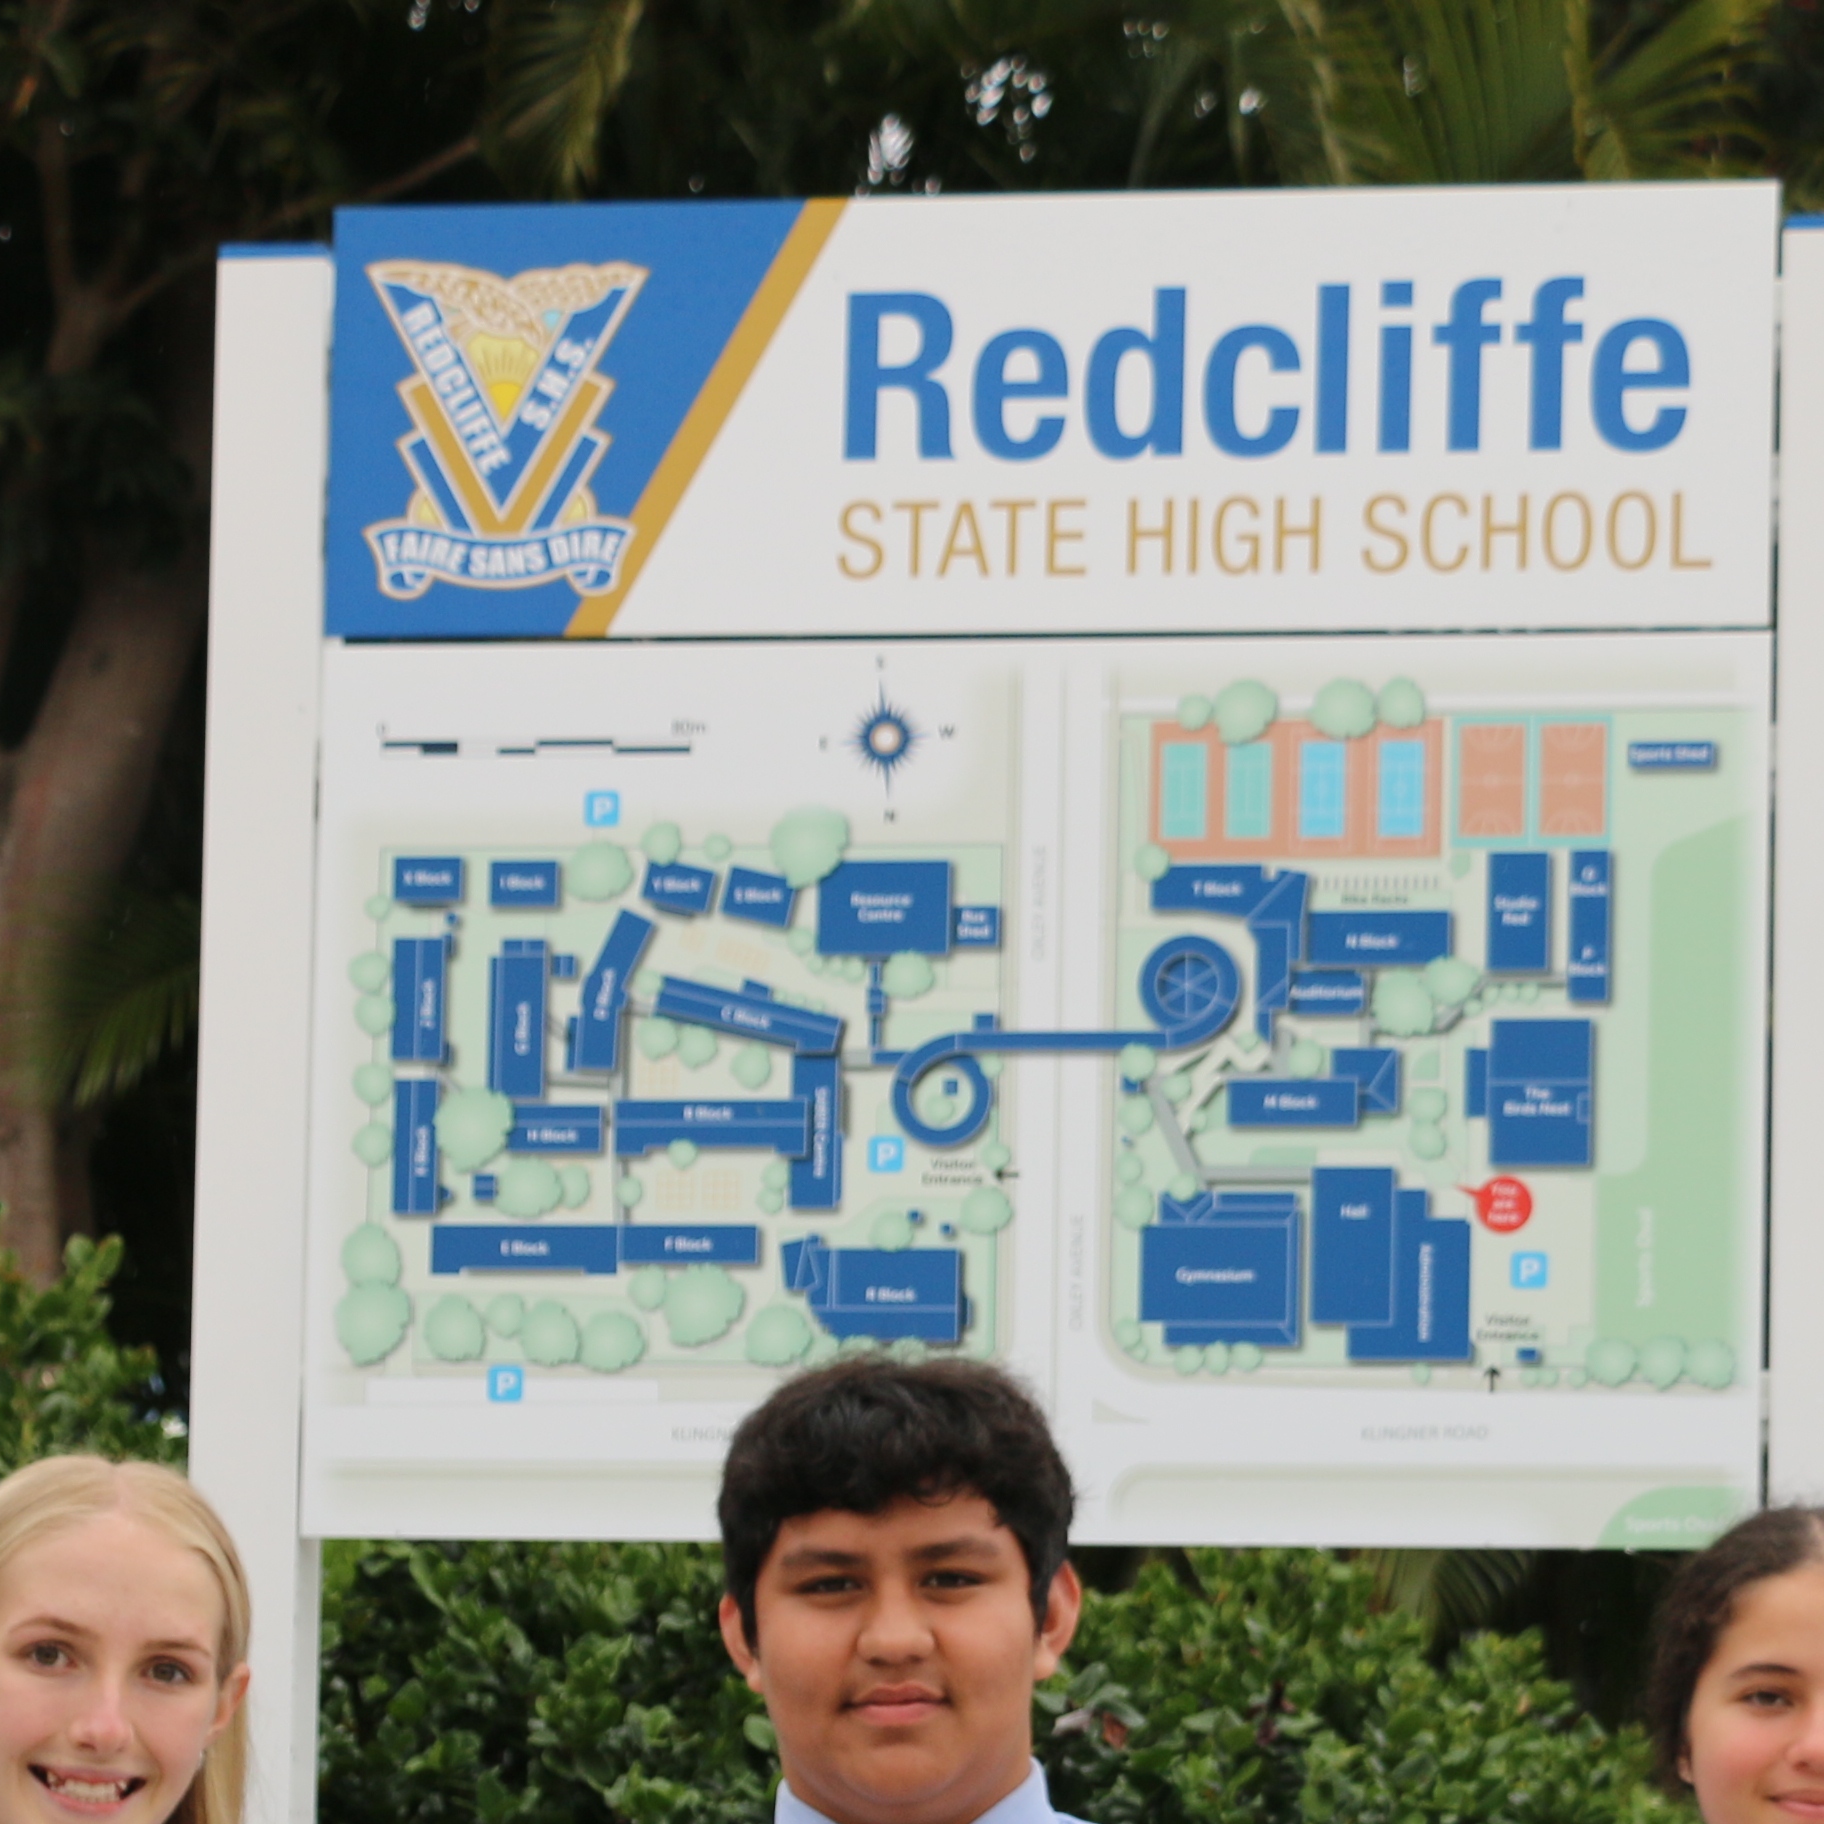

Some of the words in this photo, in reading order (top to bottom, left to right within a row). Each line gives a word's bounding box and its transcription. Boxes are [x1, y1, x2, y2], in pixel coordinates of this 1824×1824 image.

[842, 275, 1692, 462] Redcliffe
[402, 302, 511, 474] REDCLIFFE
[836, 497, 1088, 580] STATE
[1126, 495, 1323, 577] HIGH
[1360, 490, 1714, 574] SCHOOL
[384, 530, 468, 569] FAIRE
[472, 541, 546, 576] SANS
[550, 531, 619, 566] DIRE
[593, 798, 613, 820] P
[1203, 880, 1243, 897] Block
[858, 908, 904, 923] Centre
[1359, 933, 1399, 949] Block
[1289, 984, 1364, 998] Auditorium
[732, 1008, 771, 1030] Block
[1278, 1093, 1319, 1109] Block
[1503, 1100, 1537, 1117] Birds
[1539, 1101, 1571, 1116] Nest
[695, 1105, 733, 1119] Block
[541, 1128, 578, 1143] Block
[876, 1143, 896, 1168] P
[1340, 1204, 1369, 1219] Hall
[511, 1239, 550, 1255] Block
[674, 1238, 713, 1251] Block
[1175, 1266, 1256, 1286] Gymnasium
[1519, 1258, 1539, 1283] P
[877, 1287, 916, 1301] Block
[497, 1374, 516, 1396] P
